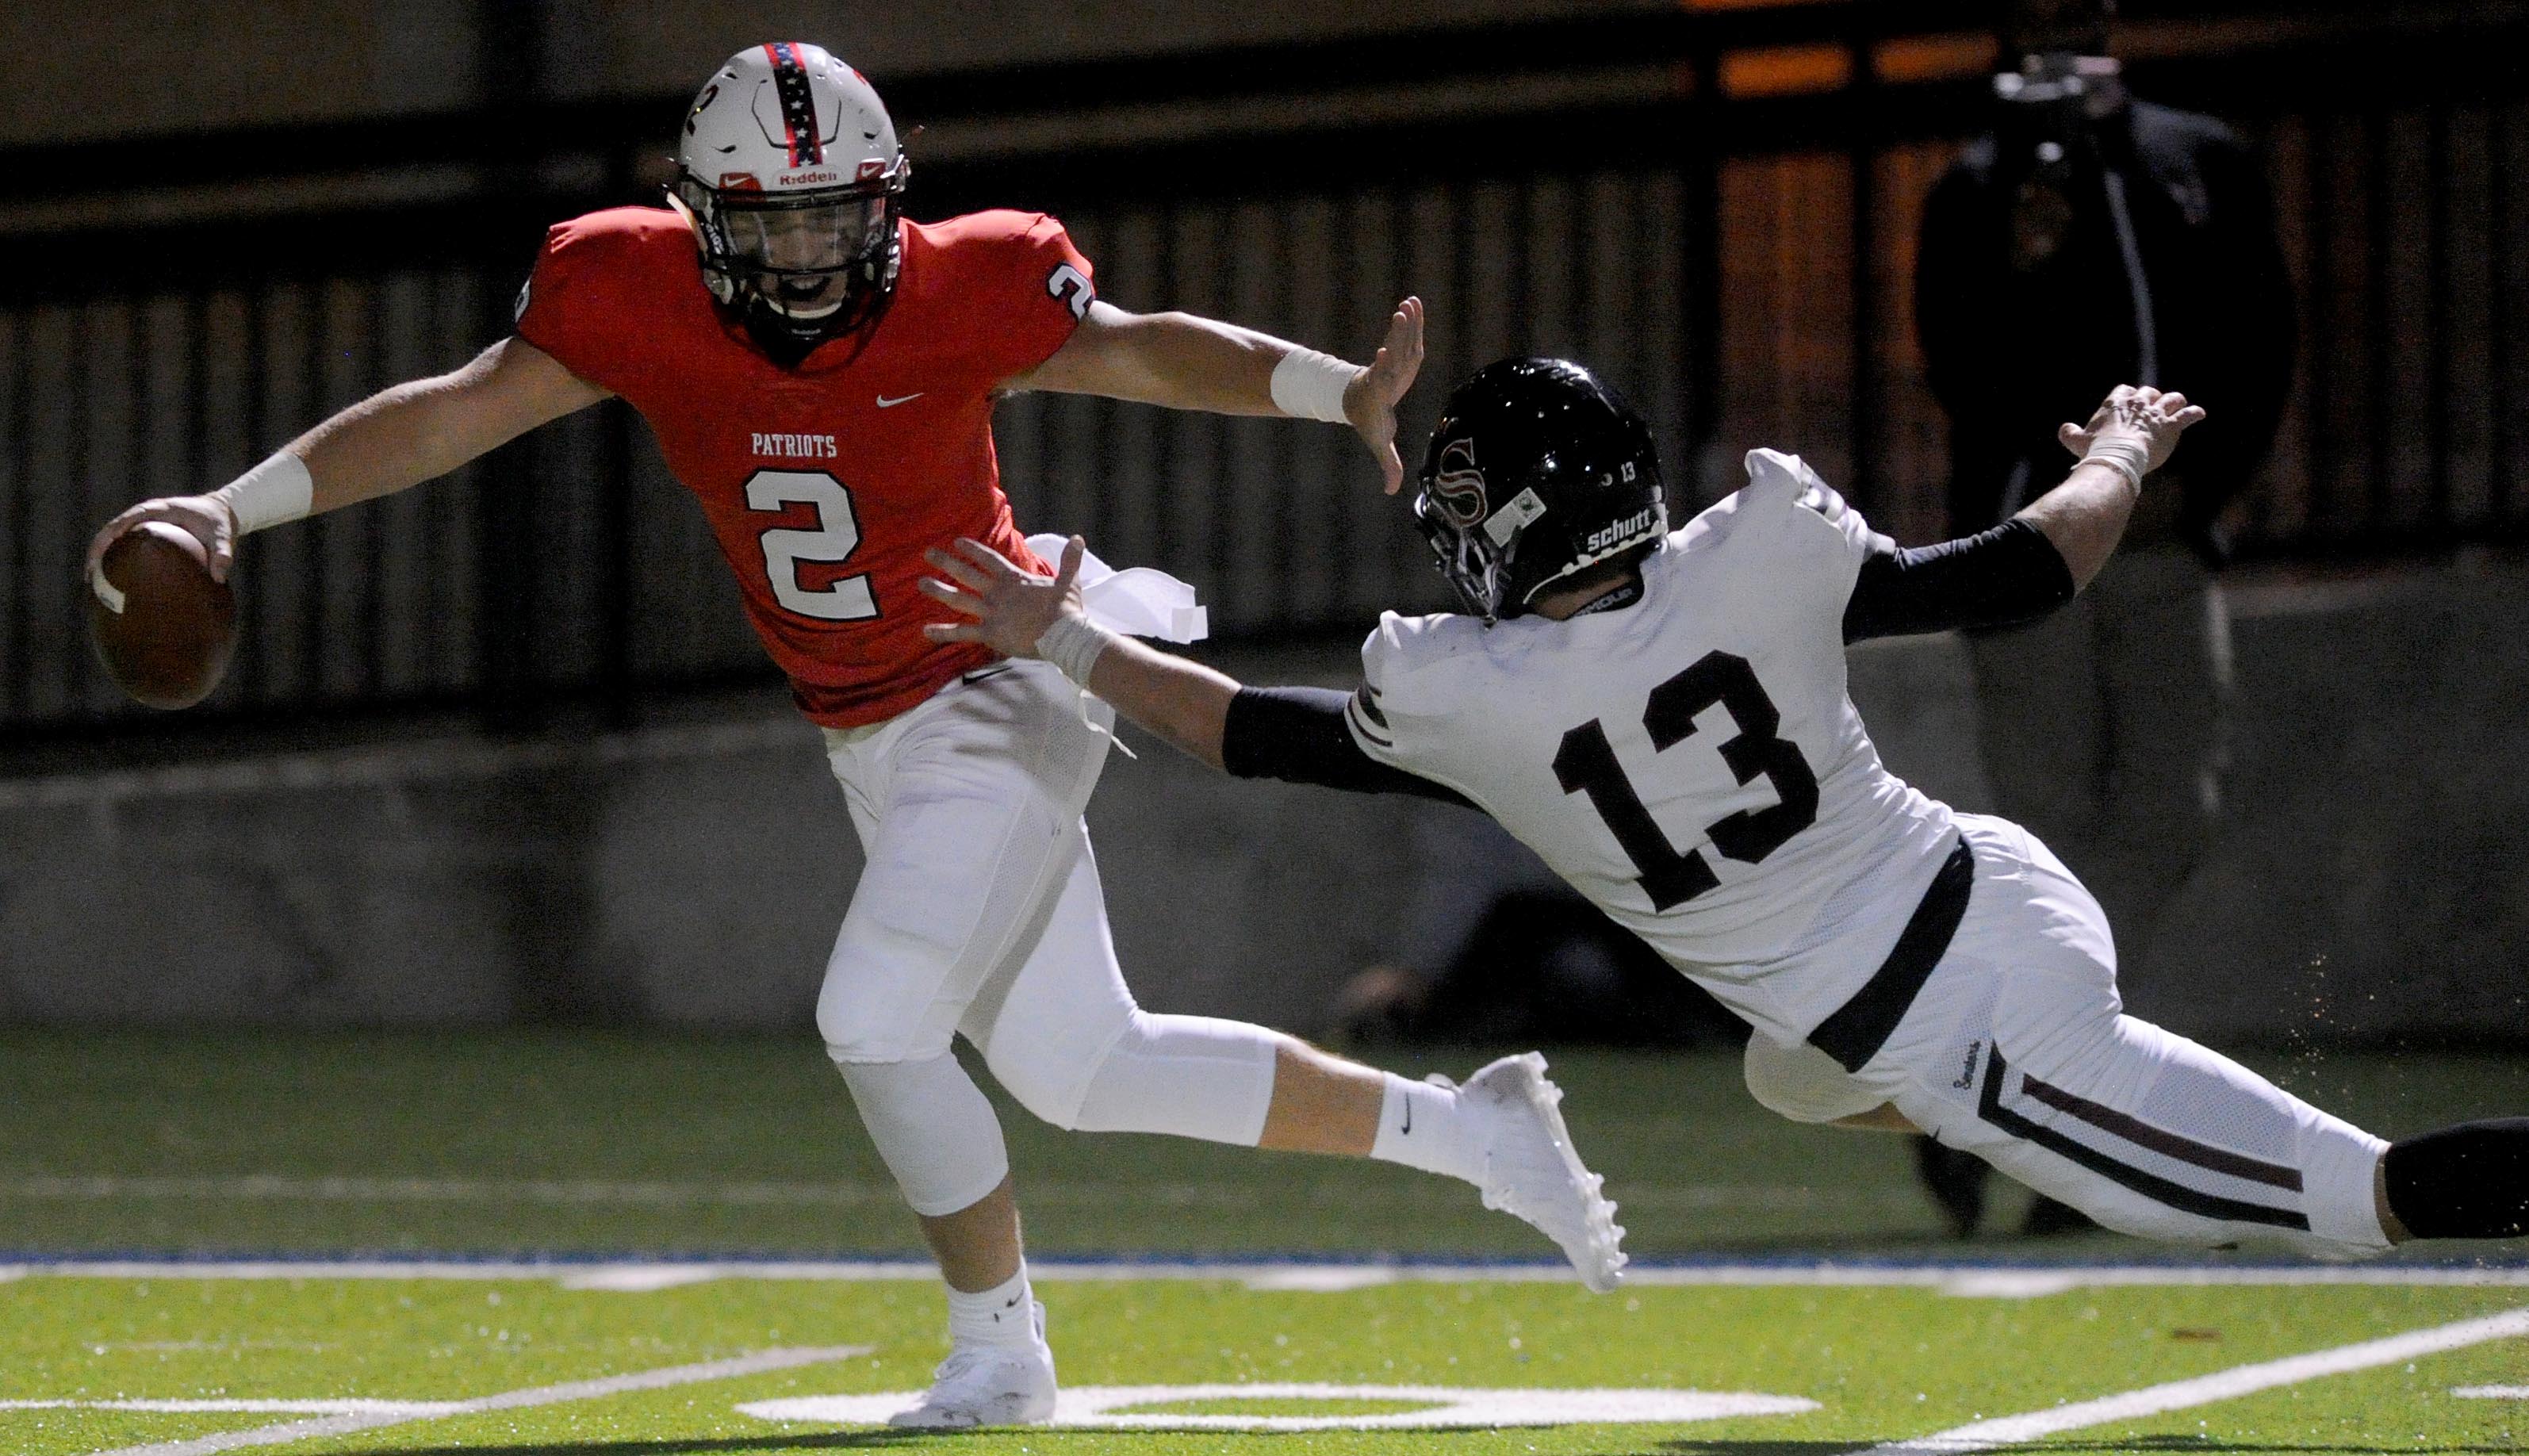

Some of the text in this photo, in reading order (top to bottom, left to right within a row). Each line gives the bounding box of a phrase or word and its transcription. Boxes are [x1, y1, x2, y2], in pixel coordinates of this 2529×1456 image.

[751, 433, 837, 458] PATRIOTS
[1620, 461, 1636, 483] 13
[1433, 437, 1488, 528] S
[743, 466, 883, 623] 2
[1587, 508, 1651, 553] schutt
[1551, 649, 1820, 914] 13
